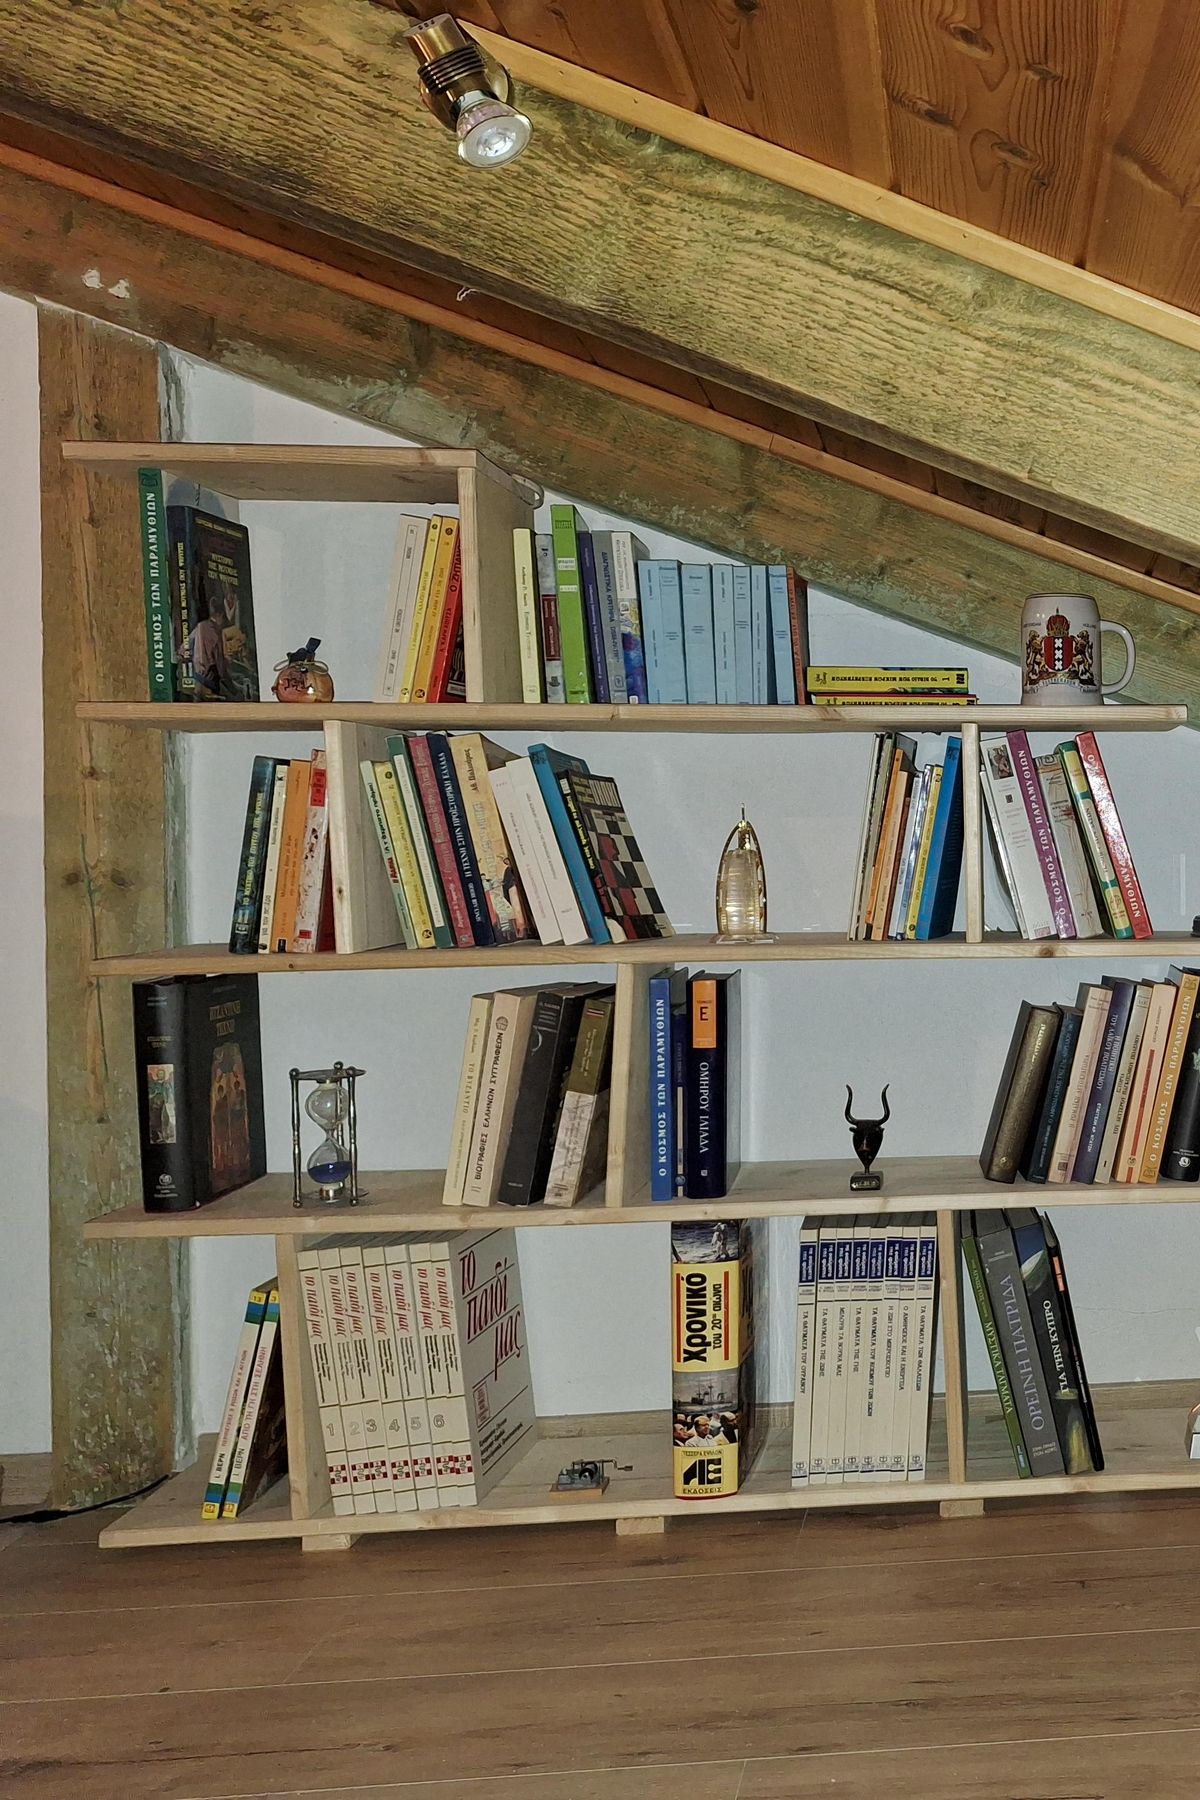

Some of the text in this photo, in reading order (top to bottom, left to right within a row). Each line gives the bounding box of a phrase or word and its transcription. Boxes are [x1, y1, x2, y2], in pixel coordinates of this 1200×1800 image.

[147, 493, 165, 682] Ο ΚΟΣΜΟΣ ΤΩΝ ΠΑΡΑΜΥΘΙΩΝ
[602, 552, 611, 592] ΔΙΑΓΝΩΣΤΙΚΑ
[1086, 754, 1095, 762] Ο
[455, 828, 465, 846] ΣΤΗΝ
[460, 848, 470, 869] ΤΕΧΝΗ
[1019, 750, 1066, 915] Ο ΚΟΣΜΟΣ ΤΩΝ ΠΑΡΑΜΥΘΙΩΝ
[656, 1000, 664, 1077] ΠΑΡΑΜΥΘΙΩΝ
[1109, 1014, 1117, 1026] ΤΟΥ
[475, 1032, 503, 1179] ΒΙΟΓΡΑΦΙΕΣ ΕΛΛΗΝΩΝ ΣΥΓΓΡΑΦΕΩΝ
[700, 1062, 709, 1152] ΟΜΗΡΟΥ ΙΛΙΑΔΑ
[1148, 996, 1190, 1161] Ο ΚΟΣΜΟΣ ΤΩΝ ΠΑΡΑΜΥΘΙΩΝ
[658, 1112, 666, 1162] ΚΟΣΜΟΣ
[346, 1272, 364, 1334] το παιδί μας
[460, 1250, 476, 1295] το
[467, 1257, 508, 1340] παιδί
[305, 1276, 323, 1337] το παιδί μας
[328, 1273, 348, 1336] το παιδί μας
[681, 1272, 710, 1363] Χρονικό
[495, 1311, 520, 1381] μας
[713, 1332, 722, 1350] του
[985, 1322, 1012, 1413] ΜΥΣΤΙΚΑ ΤΑΓΜΑΤΑ
[1000, 1276, 1044, 1430] ΟΡΕΙΝΗ ΠΑΤΡΙΔΑ
[1044, 1300, 1069, 1393] ΓΙΑ ΤΗΝ ΚΥΠΡΟ
[235, 1347, 266, 1469] ΒΕΡΝ ΑΠΟ ΤΗ ΓΗ ΣΤΗ ΣΕΛΗΝΗ
[367, 1420, 377, 1433] 3
[389, 1420, 400, 1432] 4
[411, 1417, 421, 1430] 5
[433, 1415, 444, 1428] 6
[216, 1454, 225, 1471] ΒΕΡΝ
[683, 1486, 722, 1494] ΕΚΔΟΣΕΙΣ
